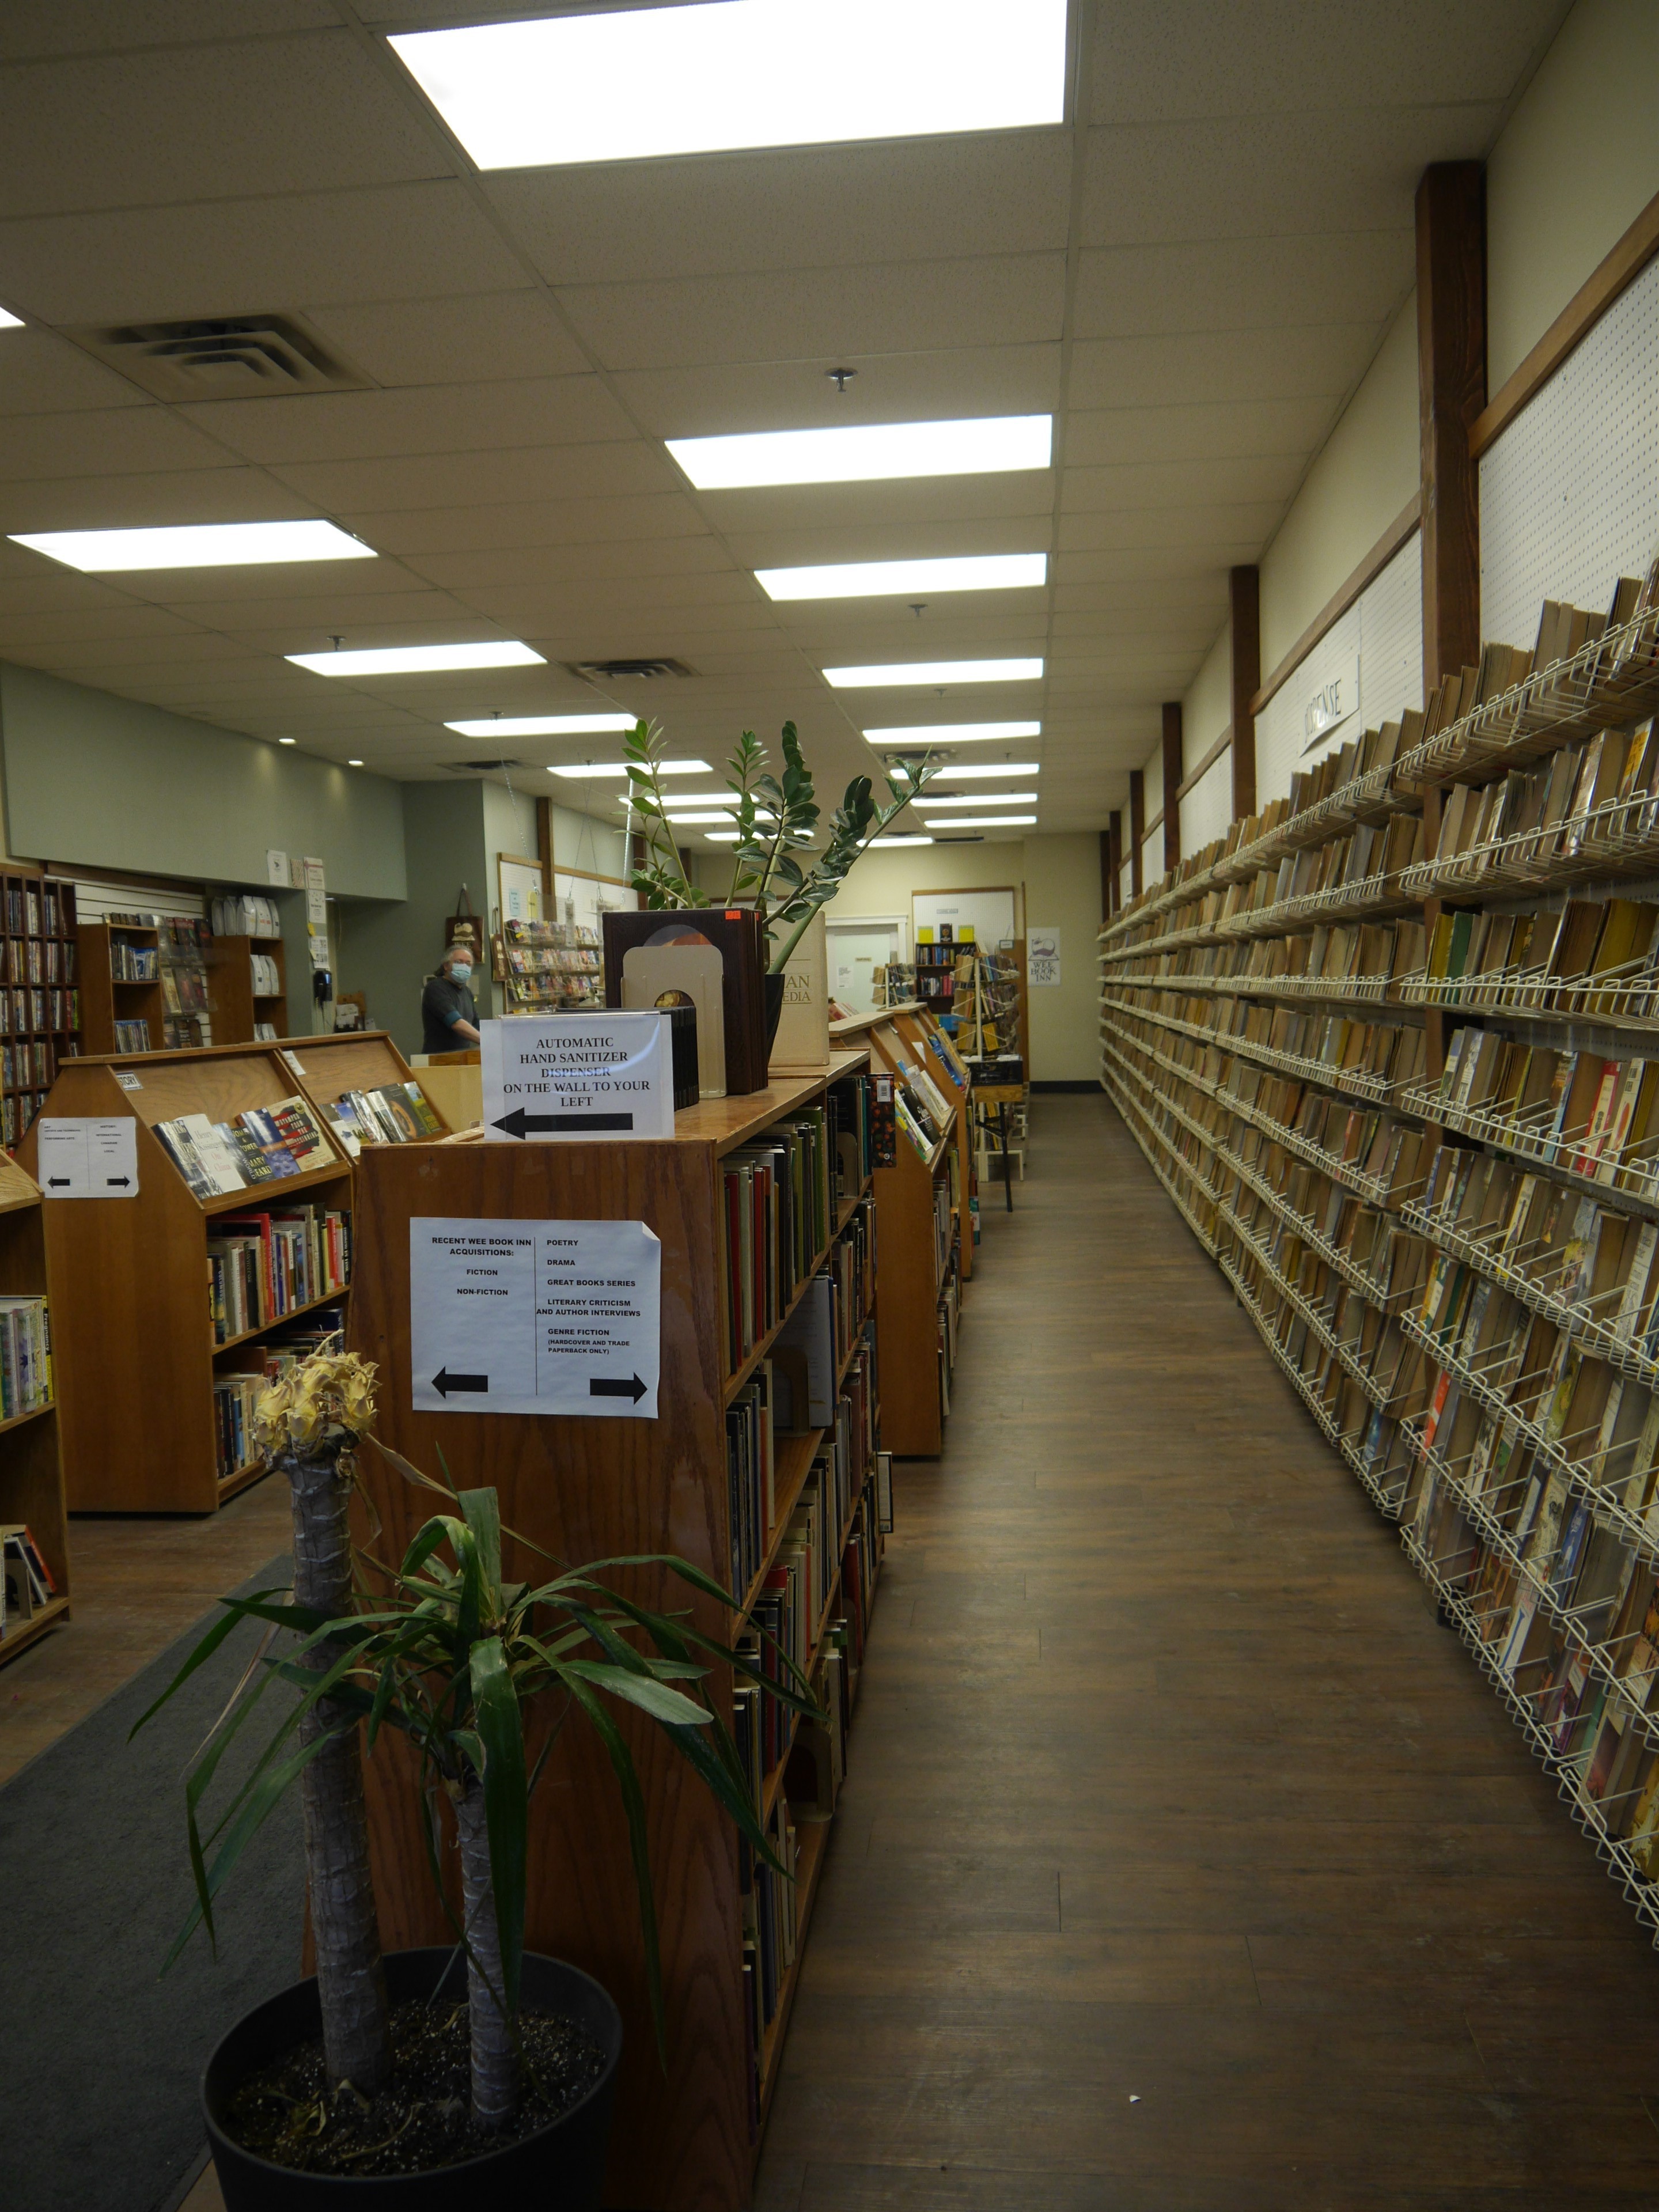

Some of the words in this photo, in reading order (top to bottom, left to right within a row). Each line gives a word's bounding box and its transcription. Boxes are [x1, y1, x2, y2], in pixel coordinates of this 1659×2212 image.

[1031, 967, 1056, 975] BOOK
[786, 975, 810, 988] AN
[1036, 974, 1051, 982] INN
[783, 991, 811, 1002] EDIA
[536, 1037, 613, 1048] AUTOMATIC
[520, 1054, 556, 1064] HAND
[559, 1052, 628, 1063] SANITIZER
[541, 1067, 611, 1078] DISPENSER
[503, 1084, 521, 1093] ON
[524, 1083, 551, 1093] THE
[554, 1082, 590, 1092] WALL
[592, 1082, 610, 1091] TO
[613, 1081, 650, 1091] YOUR
[561, 1097, 593, 1107] LEFT
[248, 1156, 265, 1168] MARY
[449, 1248, 514, 1256] ACQUISITIONS:
